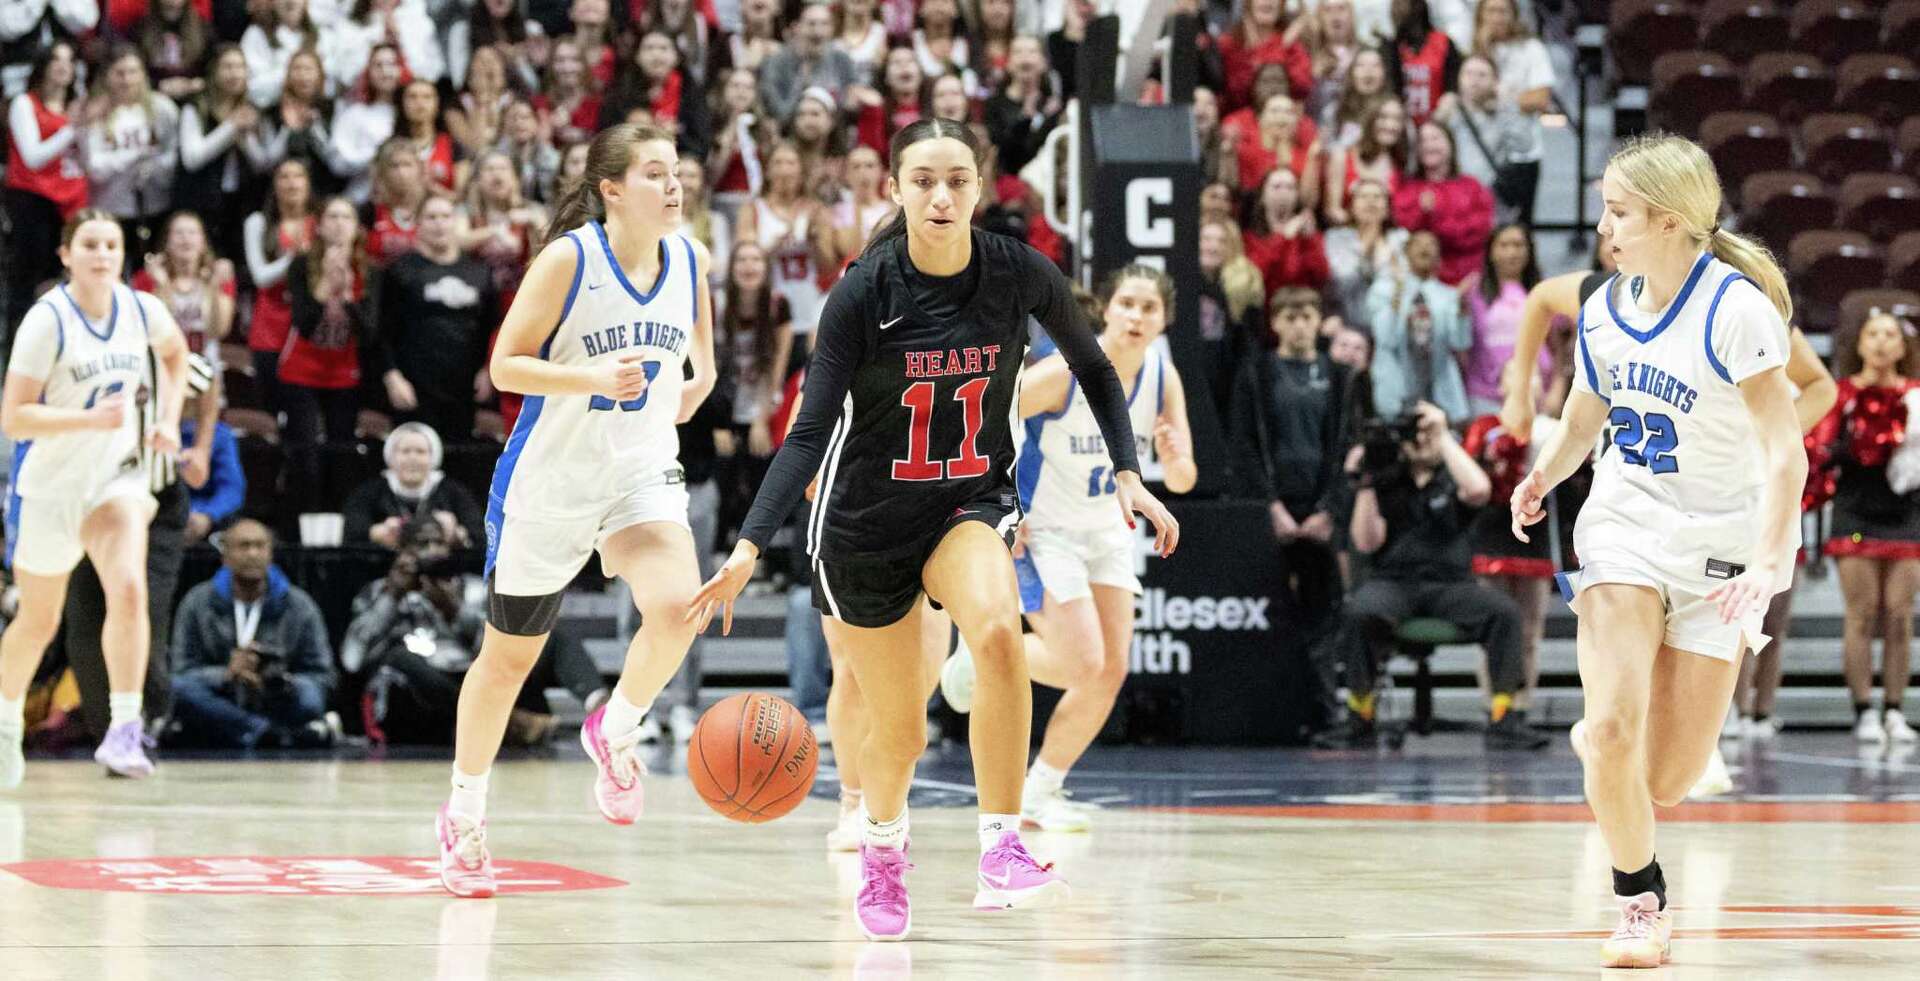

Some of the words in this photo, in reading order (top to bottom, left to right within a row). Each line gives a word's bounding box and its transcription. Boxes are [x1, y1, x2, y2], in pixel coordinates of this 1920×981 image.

[582, 325, 628, 358] BLUE
[905, 345, 1001, 377] HEART
[1627, 362, 1698, 414] KNIGHTS
[891, 377, 991, 480] 11
[1070, 435, 1104, 454] BLUE
[1608, 406, 1679, 475] 22
[1133, 587, 1270, 630] dlesex
[1130, 631, 1192, 674] lth
